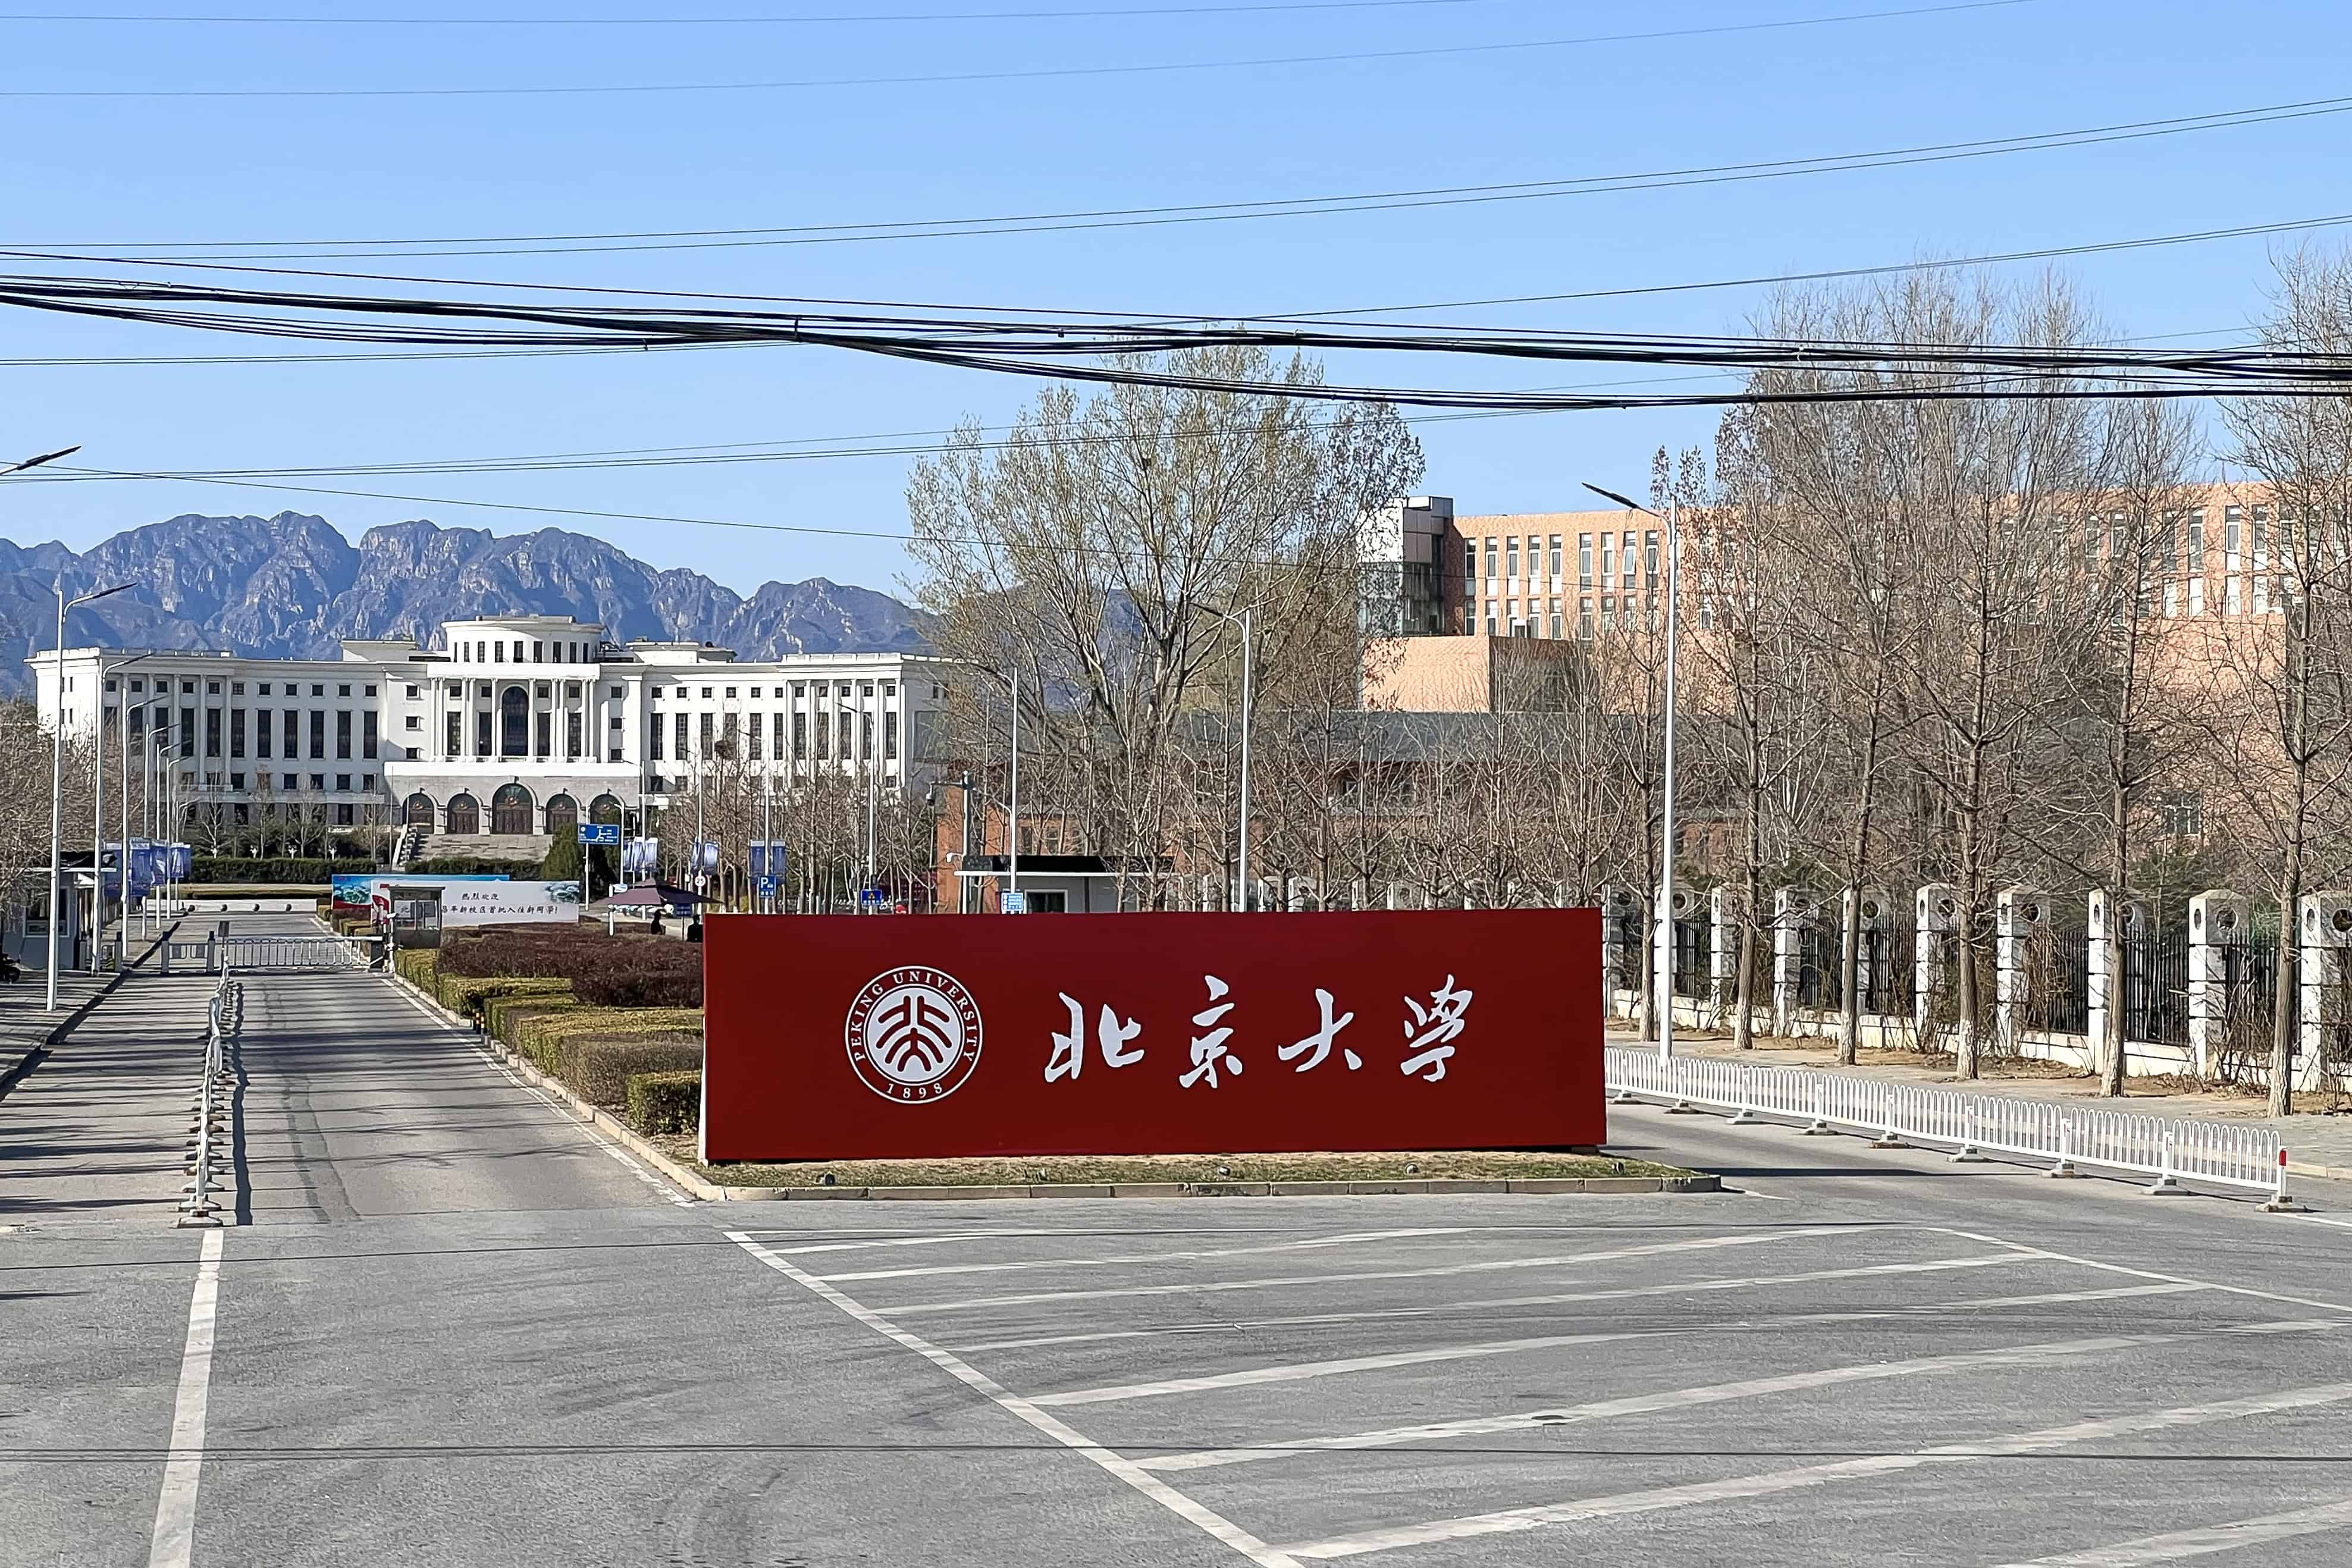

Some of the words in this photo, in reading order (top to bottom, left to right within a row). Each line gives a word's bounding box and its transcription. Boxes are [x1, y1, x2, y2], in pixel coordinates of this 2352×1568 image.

[761, 877, 768, 888] P
[462, 892, 500, 901] 热烈欢迎
[851, 984, 883, 1062] PEKING
[893, 971, 977, 1062] UNIVERSITY
[1044, 974, 1473, 1089] 北京大学
[886, 1083, 943, 1099] 1898
